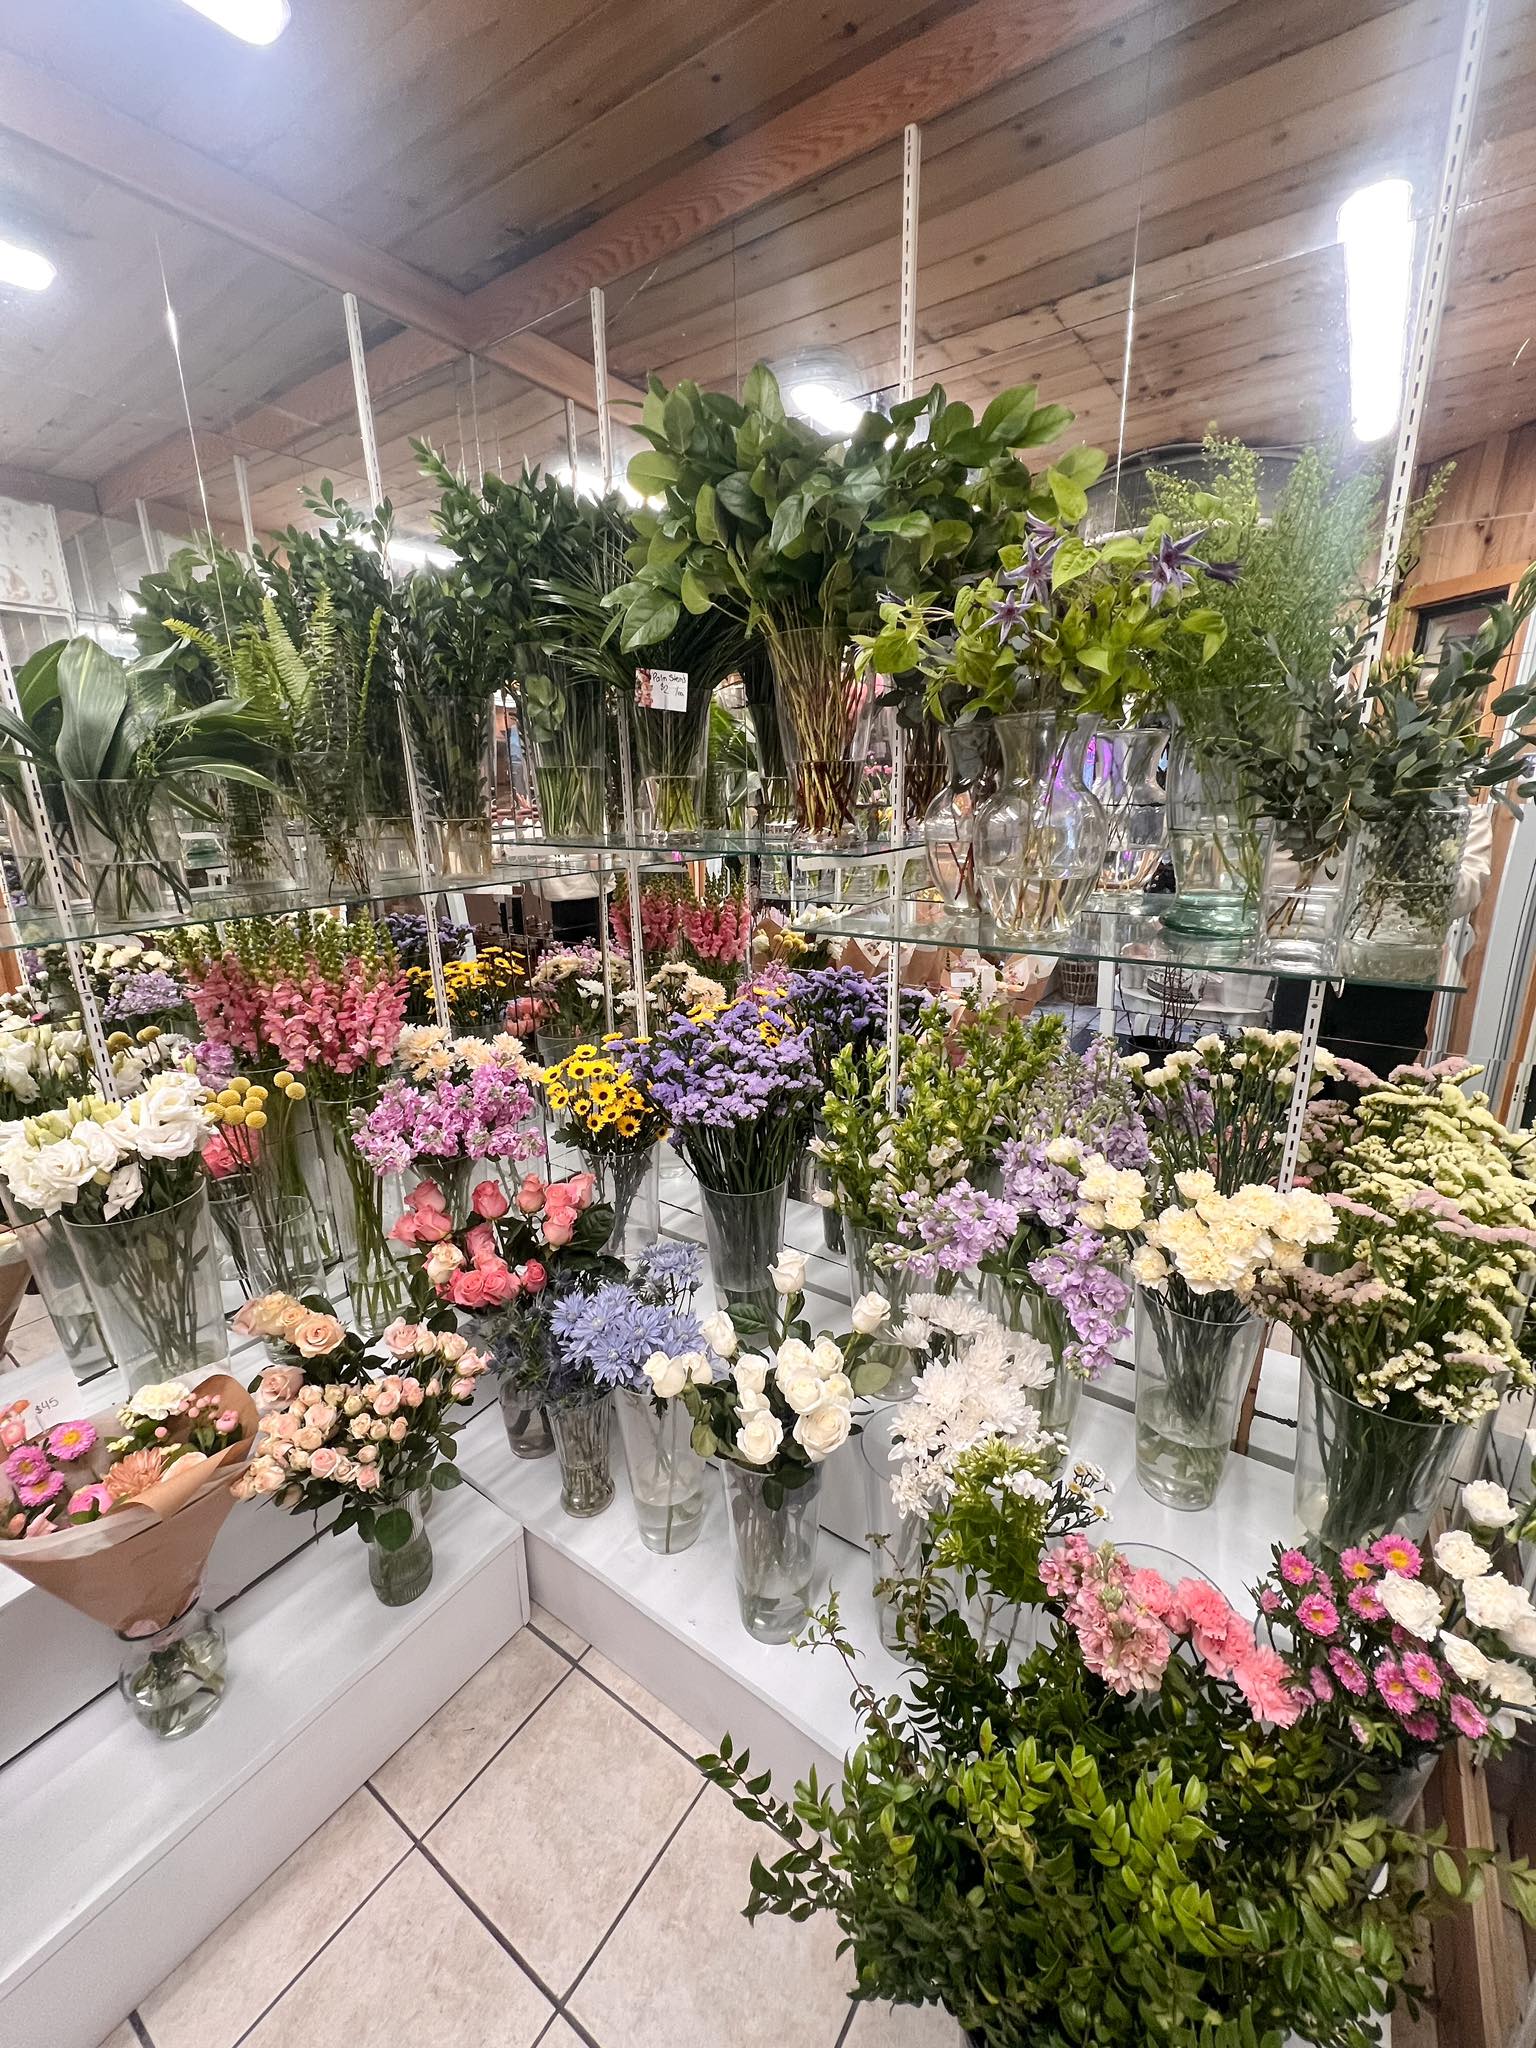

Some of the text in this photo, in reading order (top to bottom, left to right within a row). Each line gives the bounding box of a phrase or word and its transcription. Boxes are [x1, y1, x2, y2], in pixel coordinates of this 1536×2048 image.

[653, 672, 668, 683] Palm
[660, 682, 669, 694] $2
[34, 1396, 59, 1414] $45
